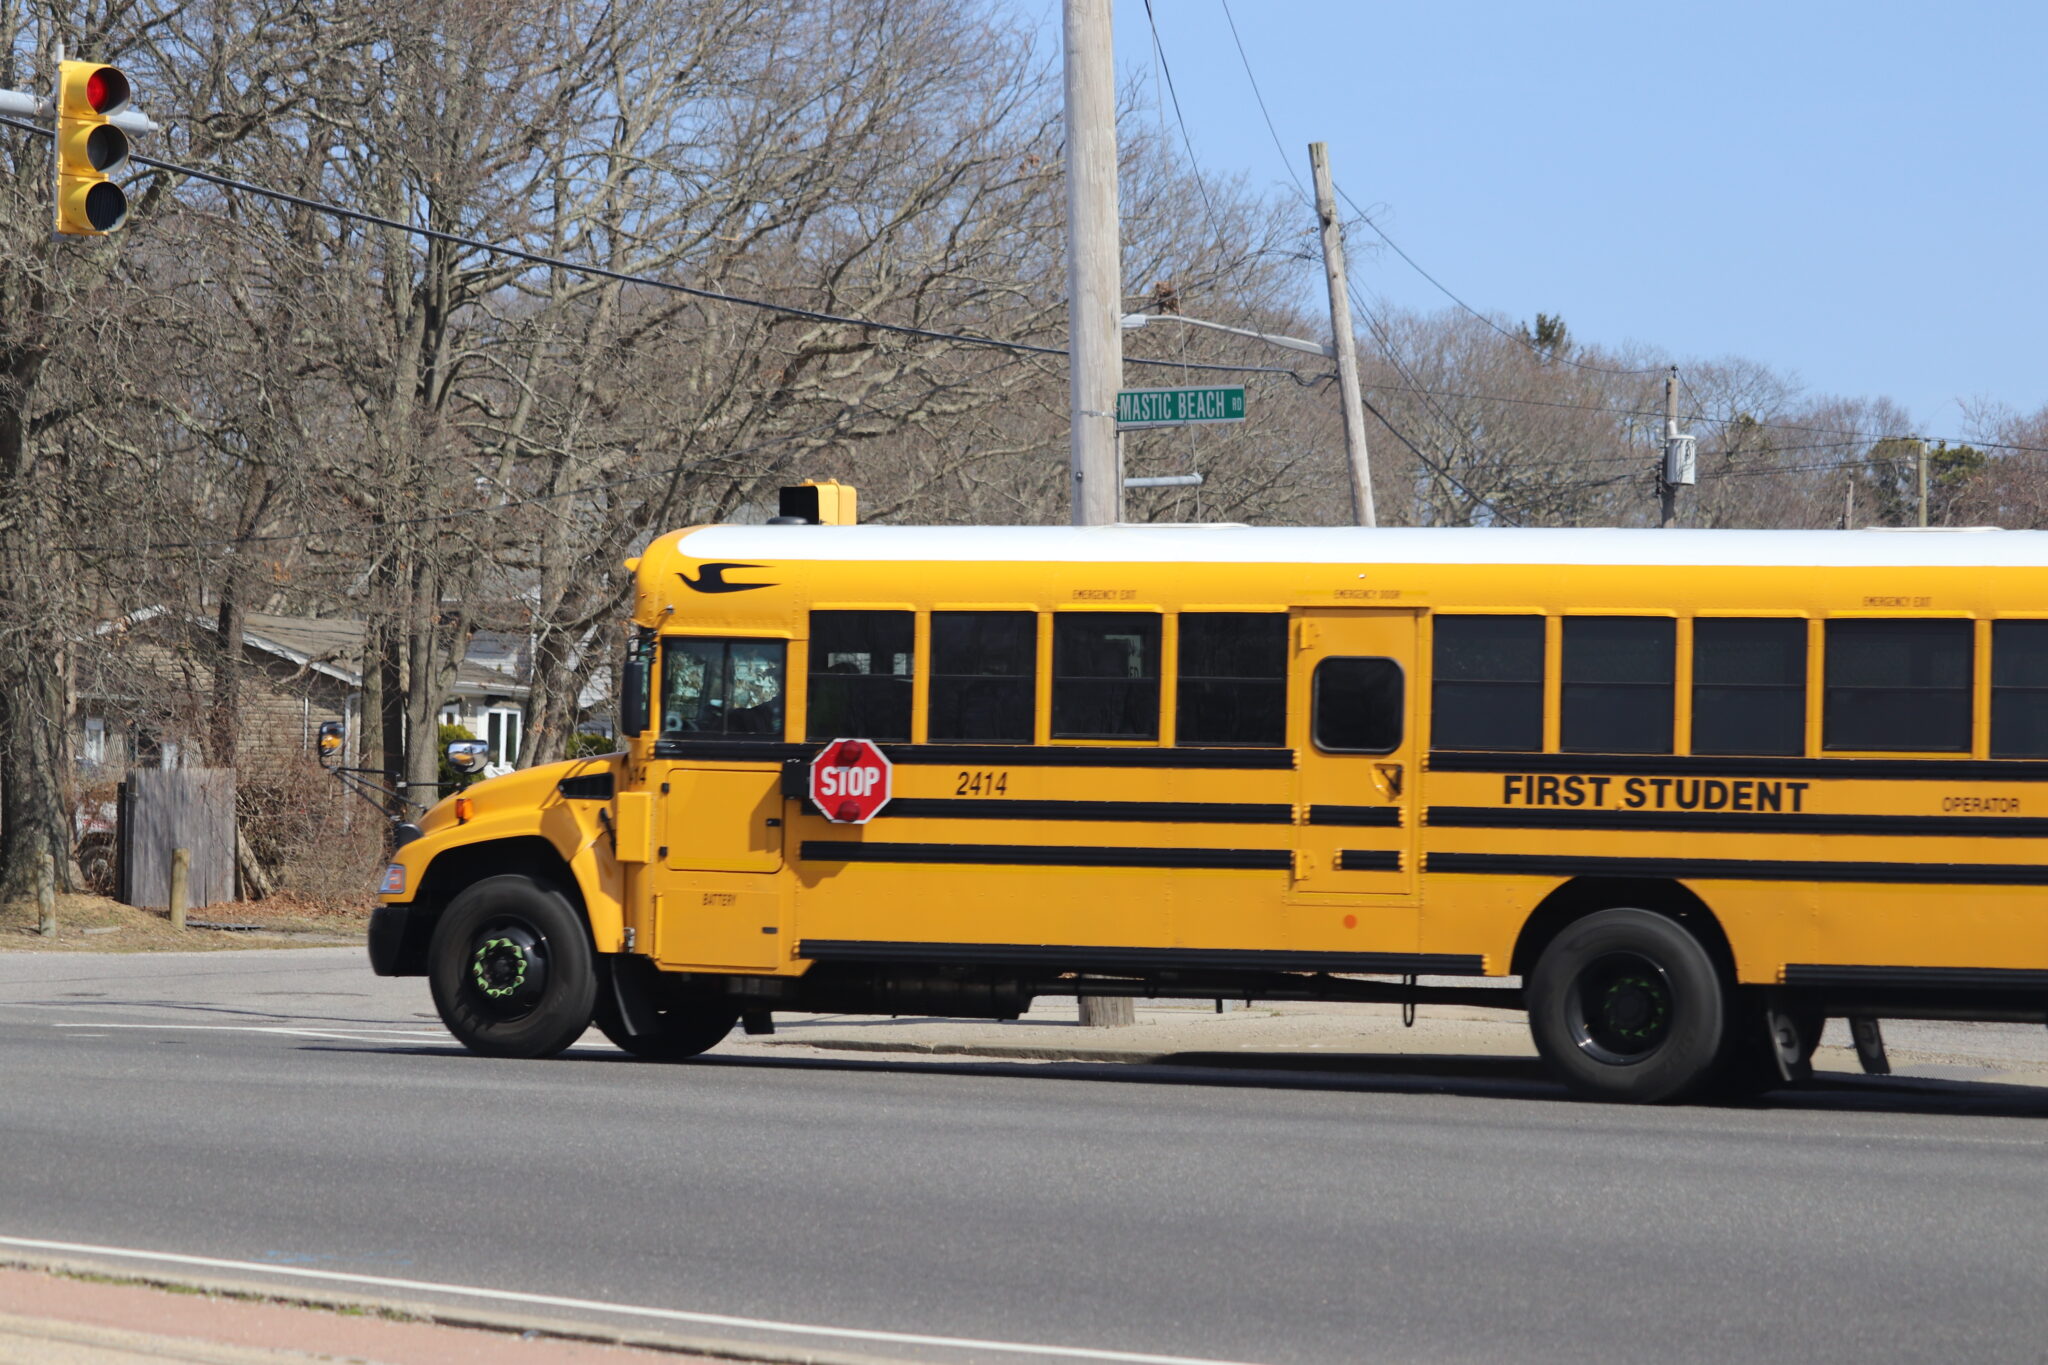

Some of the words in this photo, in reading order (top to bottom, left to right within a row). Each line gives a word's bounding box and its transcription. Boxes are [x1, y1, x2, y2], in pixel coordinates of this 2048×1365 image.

[1120, 393, 1172, 421] MASTIC
[1178, 391, 1225, 419] BEACH
[1232, 397, 1242, 411] RD
[820, 766, 880, 797] STOP
[956, 771, 1008, 796] 2414
[1503, 775, 1611, 807] FIRST
[1624, 777, 1809, 812] STUDENT
[1943, 797, 2020, 812] OPERATOR
[702, 893, 737, 907] BATTERY
